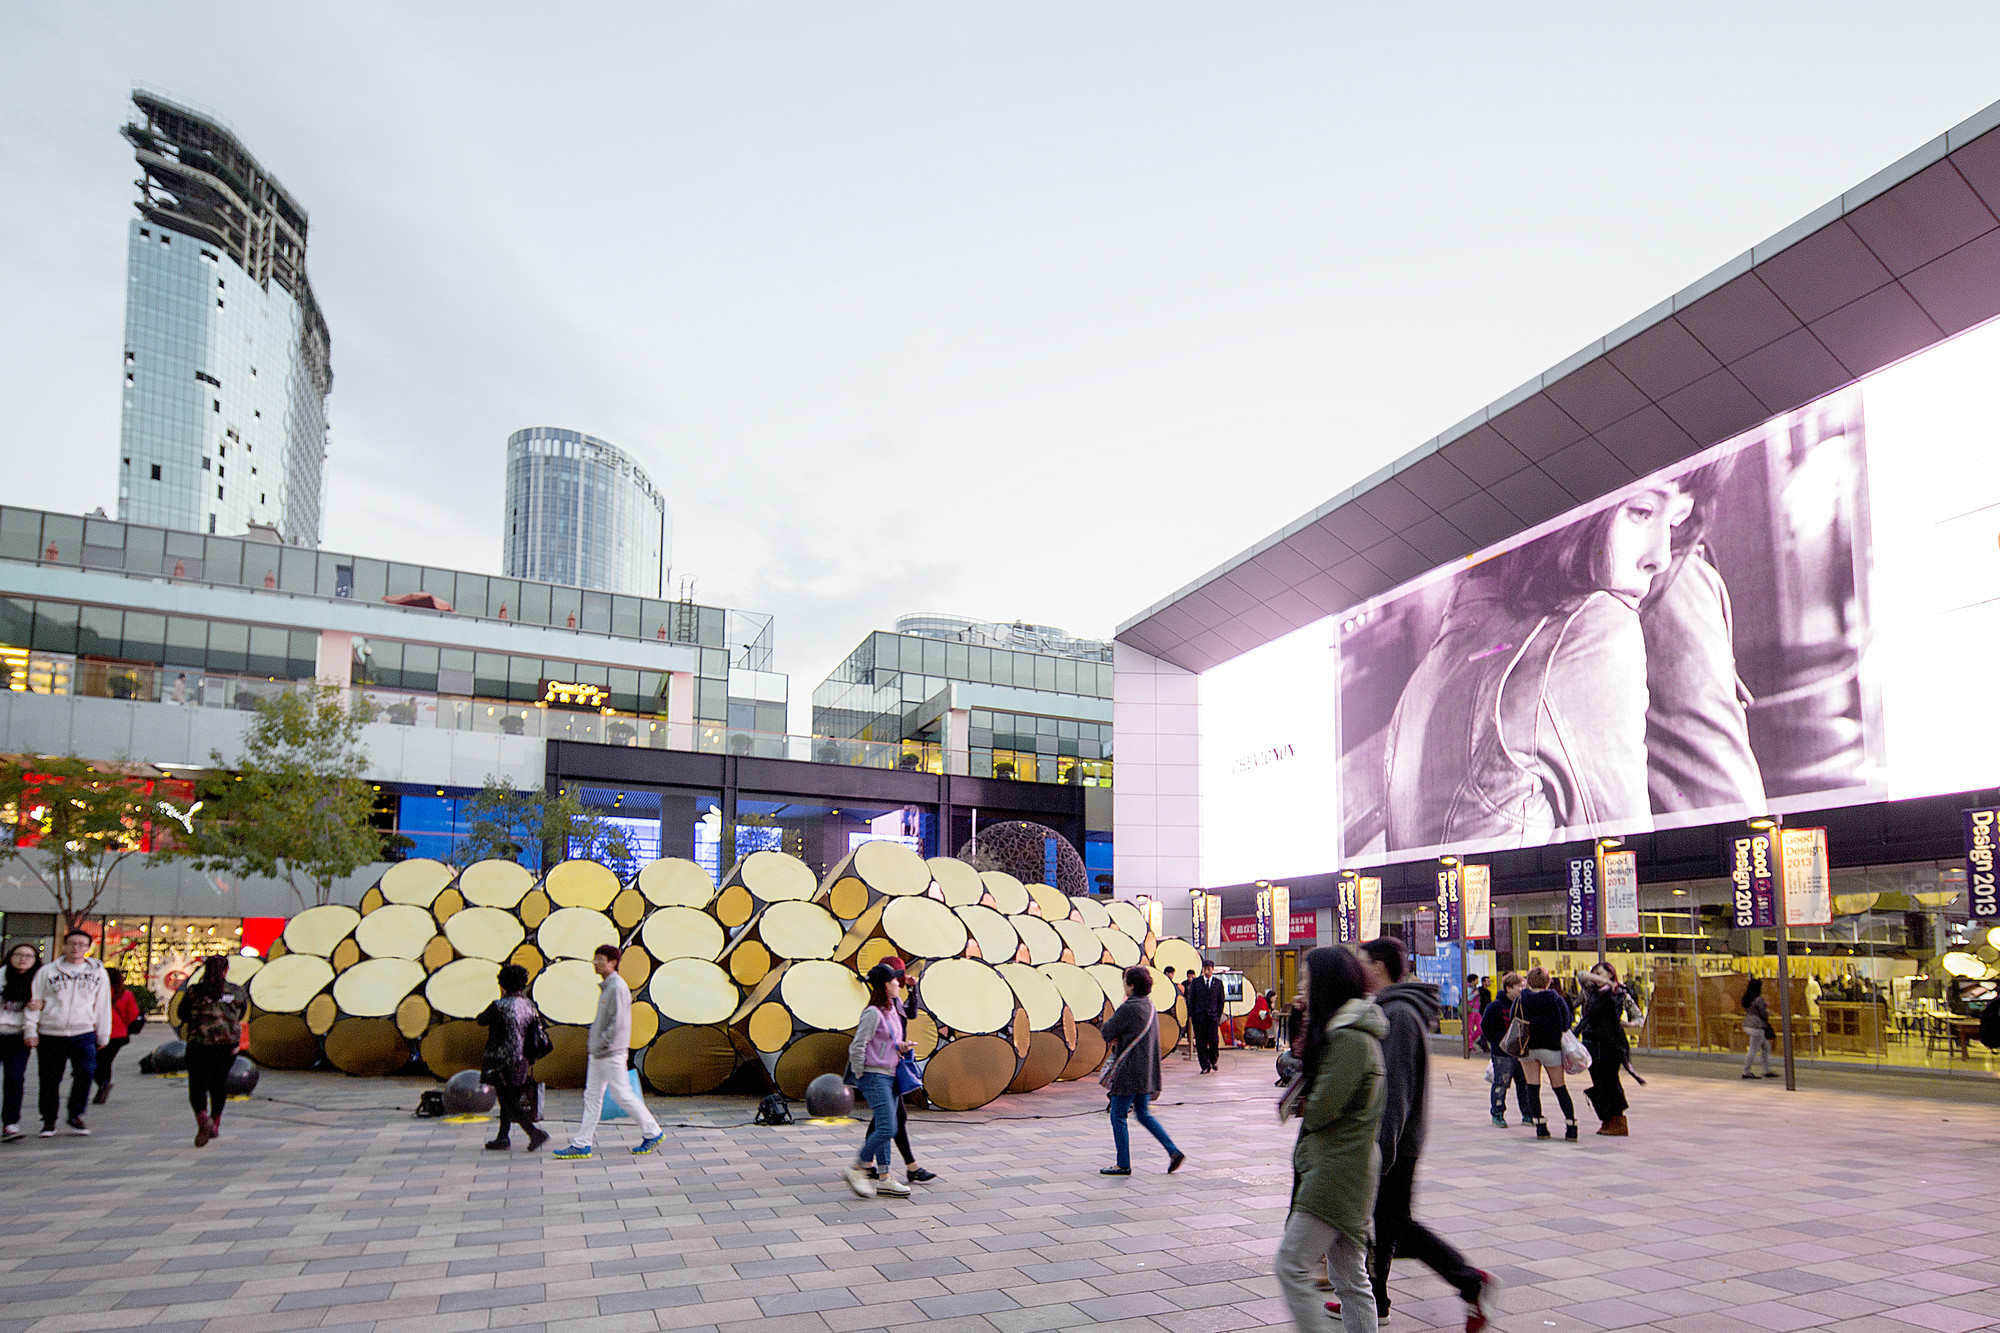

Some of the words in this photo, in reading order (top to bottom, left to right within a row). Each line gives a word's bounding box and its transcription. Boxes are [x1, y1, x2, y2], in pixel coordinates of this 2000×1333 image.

[1785, 833, 1813, 844] Good
[1786, 845, 1823, 856] Design
[1969, 810, 1997, 872] Design
[1606, 857, 1627, 866] Good
[1607, 867, 1634, 876] Design
[1732, 838, 1753, 890] Design
[1752, 836, 1772, 878] Good
[1787, 858, 1813, 868] 2013
[1448, 870, 1459, 903] Good
[1569, 860, 1583, 904] Design
[1583, 859, 1596, 894] Good
[1608, 877, 1627, 886] 2013
[1346, 881, 1357, 910] Good
[1437, 872, 1449, 911] Design
[1973, 873, 1998, 916] 2013
[1570, 905, 1582, 935] 2013
[1735, 891, 1753, 927] 2013
[1257, 923, 1265, 946] 2013
[1340, 917, 1349, 942] 2013
[1439, 911, 1449, 938] 2013
